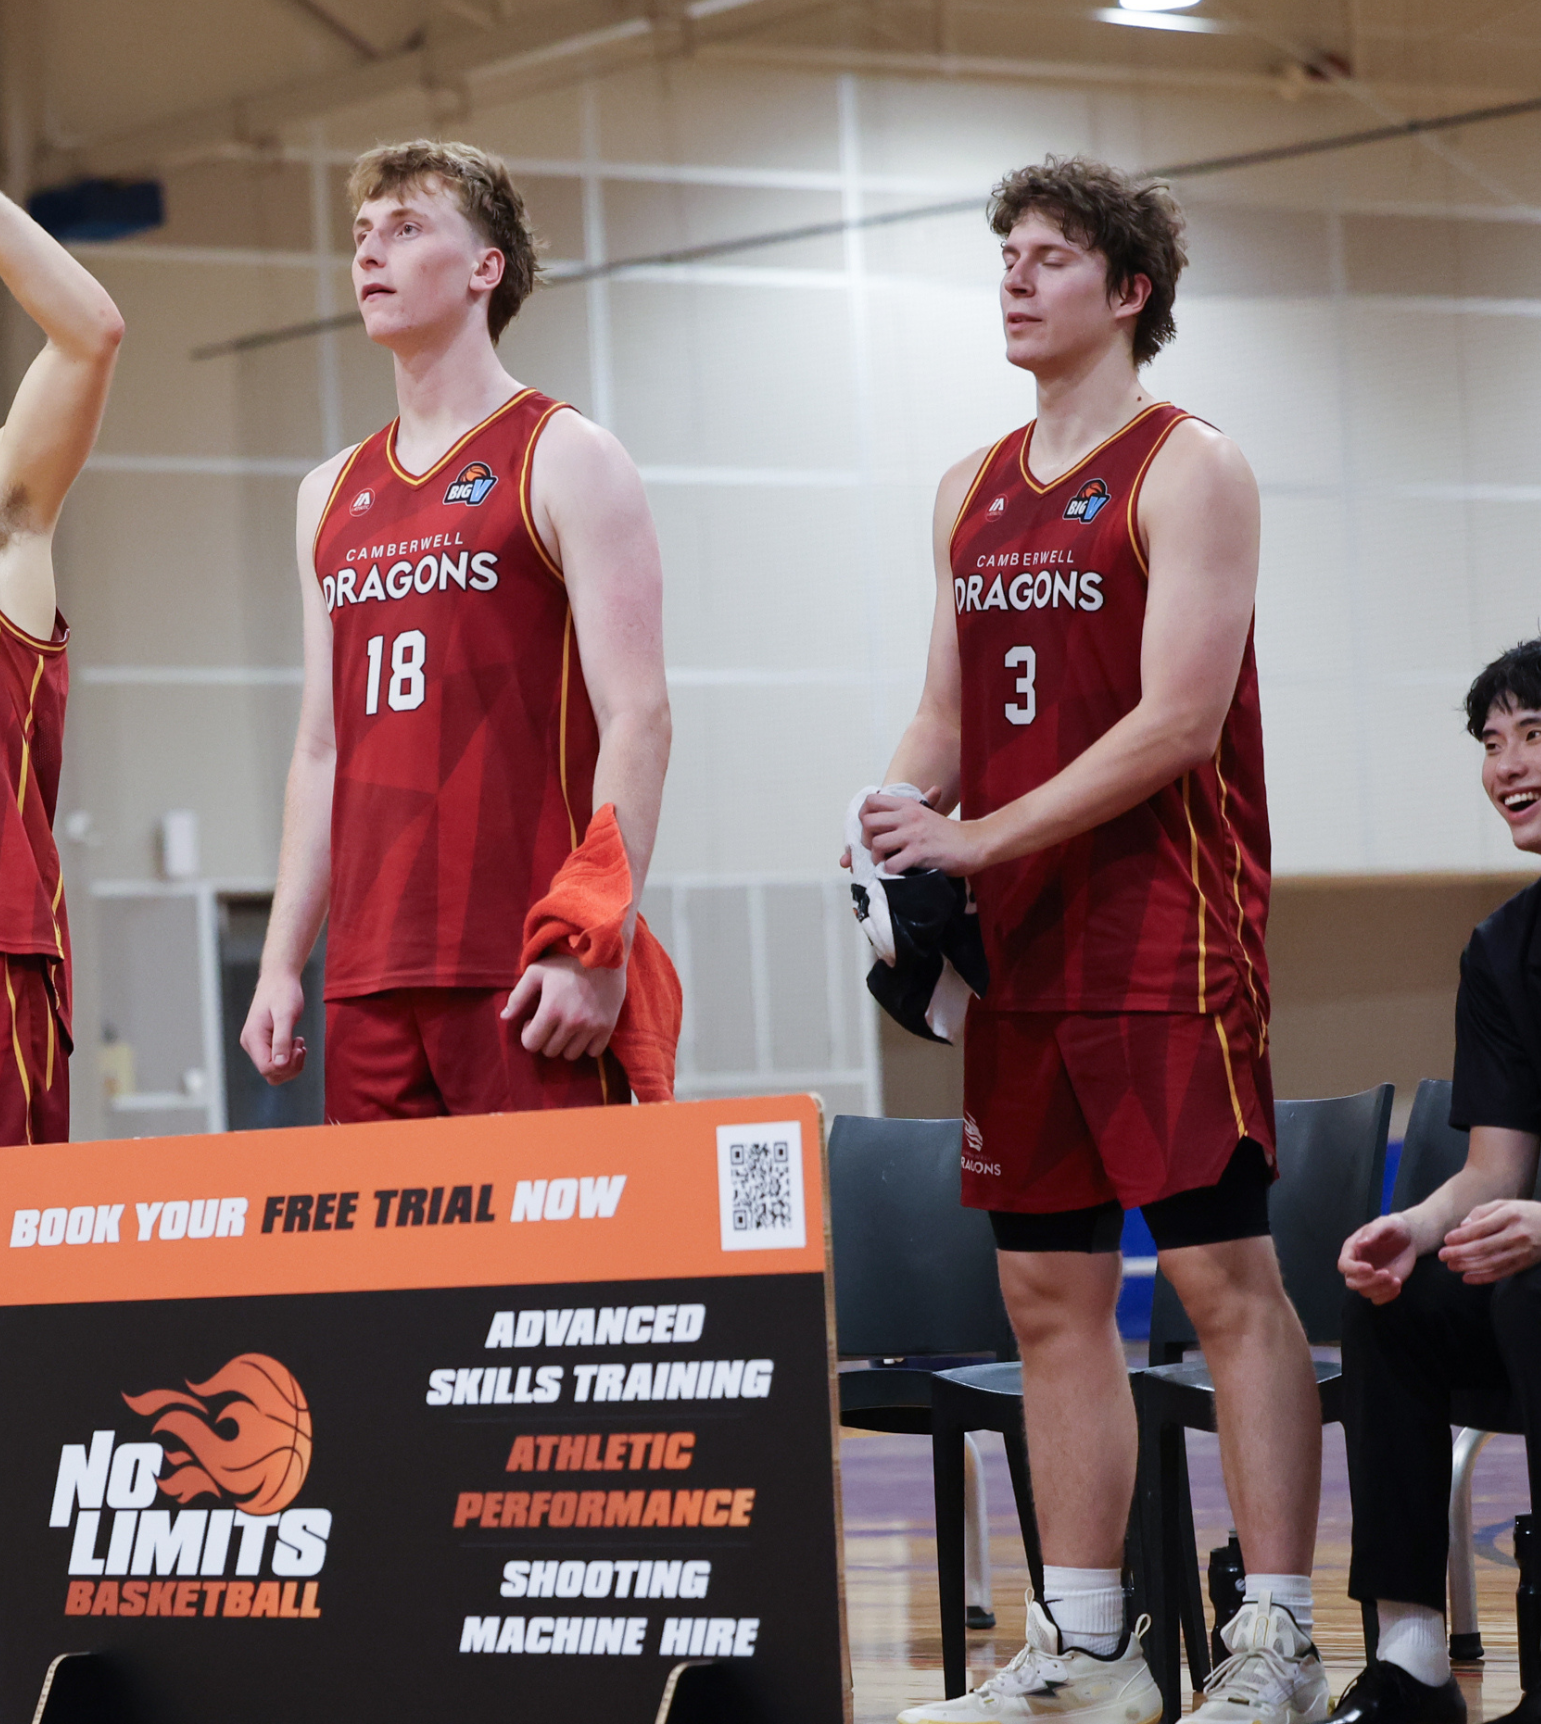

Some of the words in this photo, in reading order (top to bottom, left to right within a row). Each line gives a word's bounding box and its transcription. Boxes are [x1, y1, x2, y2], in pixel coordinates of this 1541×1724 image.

[346, 531, 464, 562] CAMBERWELL
[977, 550, 1074, 568] CAMBERWELL
[322, 551, 499, 614] DRAGONS
[954, 570, 1104, 615] DRAGONS
[365, 629, 427, 716] 18
[1004, 645, 1037, 725] 3
[9, 1204, 126, 1248] BOOK
[135, 1197, 249, 1242] YOUR
[261, 1191, 360, 1234] FREE
[374, 1184, 496, 1228] TRIAL
[510, 1175, 627, 1222] NOW
[484, 1304, 705, 1349] ADVANCED
[427, 1365, 564, 1406] SKILLS
[573, 1359, 774, 1403] TRAINING
[505, 1432, 696, 1472] ATHLETIC
[49, 1430, 163, 1528] NO
[453, 1488, 756, 1528] PERFORMANCE
[68, 1507, 333, 1577] LIMITS
[64, 1580, 322, 1619] BASKETBALL
[500, 1560, 711, 1599] SHOOTING
[459, 1616, 647, 1655] MACHINE
[659, 1617, 760, 1657] HIRE
